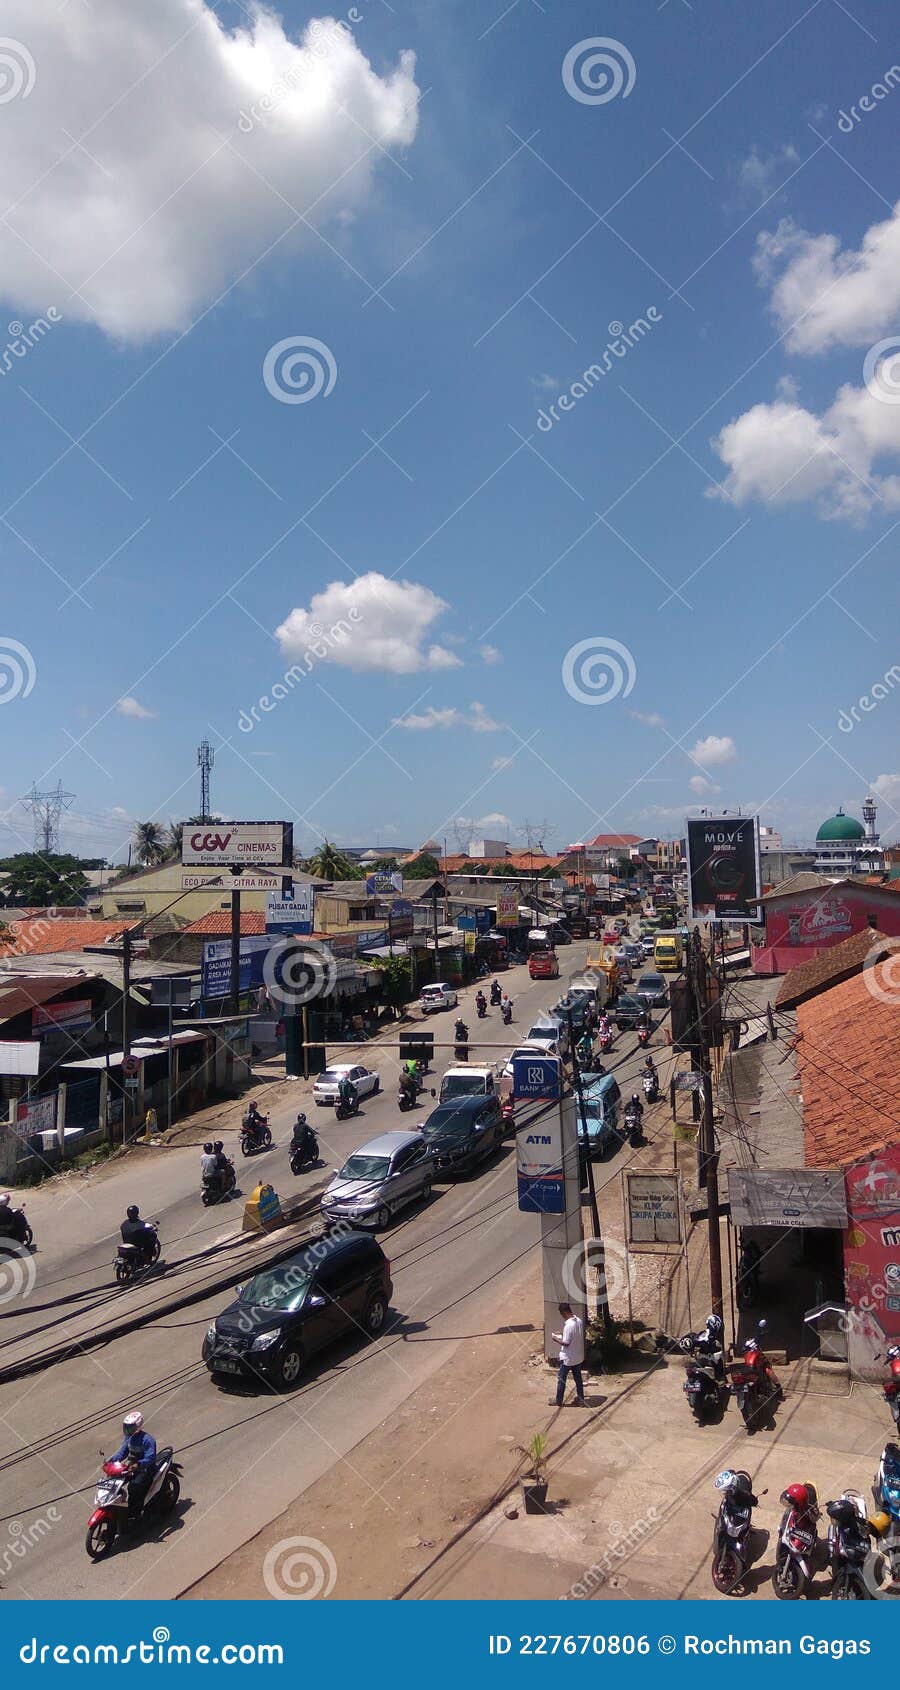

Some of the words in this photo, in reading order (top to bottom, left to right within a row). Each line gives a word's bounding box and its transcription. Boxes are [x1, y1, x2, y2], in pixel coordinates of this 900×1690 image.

[190, 833, 232, 851] CGV
[704, 832, 744, 843] MOVE
[237, 843, 277, 852] CINEMAS
[233, 879, 255, 887] CITRA
[258, 879, 278, 887] RAYA
[268, 903, 288, 911] PUSAT
[289, 903, 308, 911] GADAI
[525, 1135, 551, 1145] ATM
